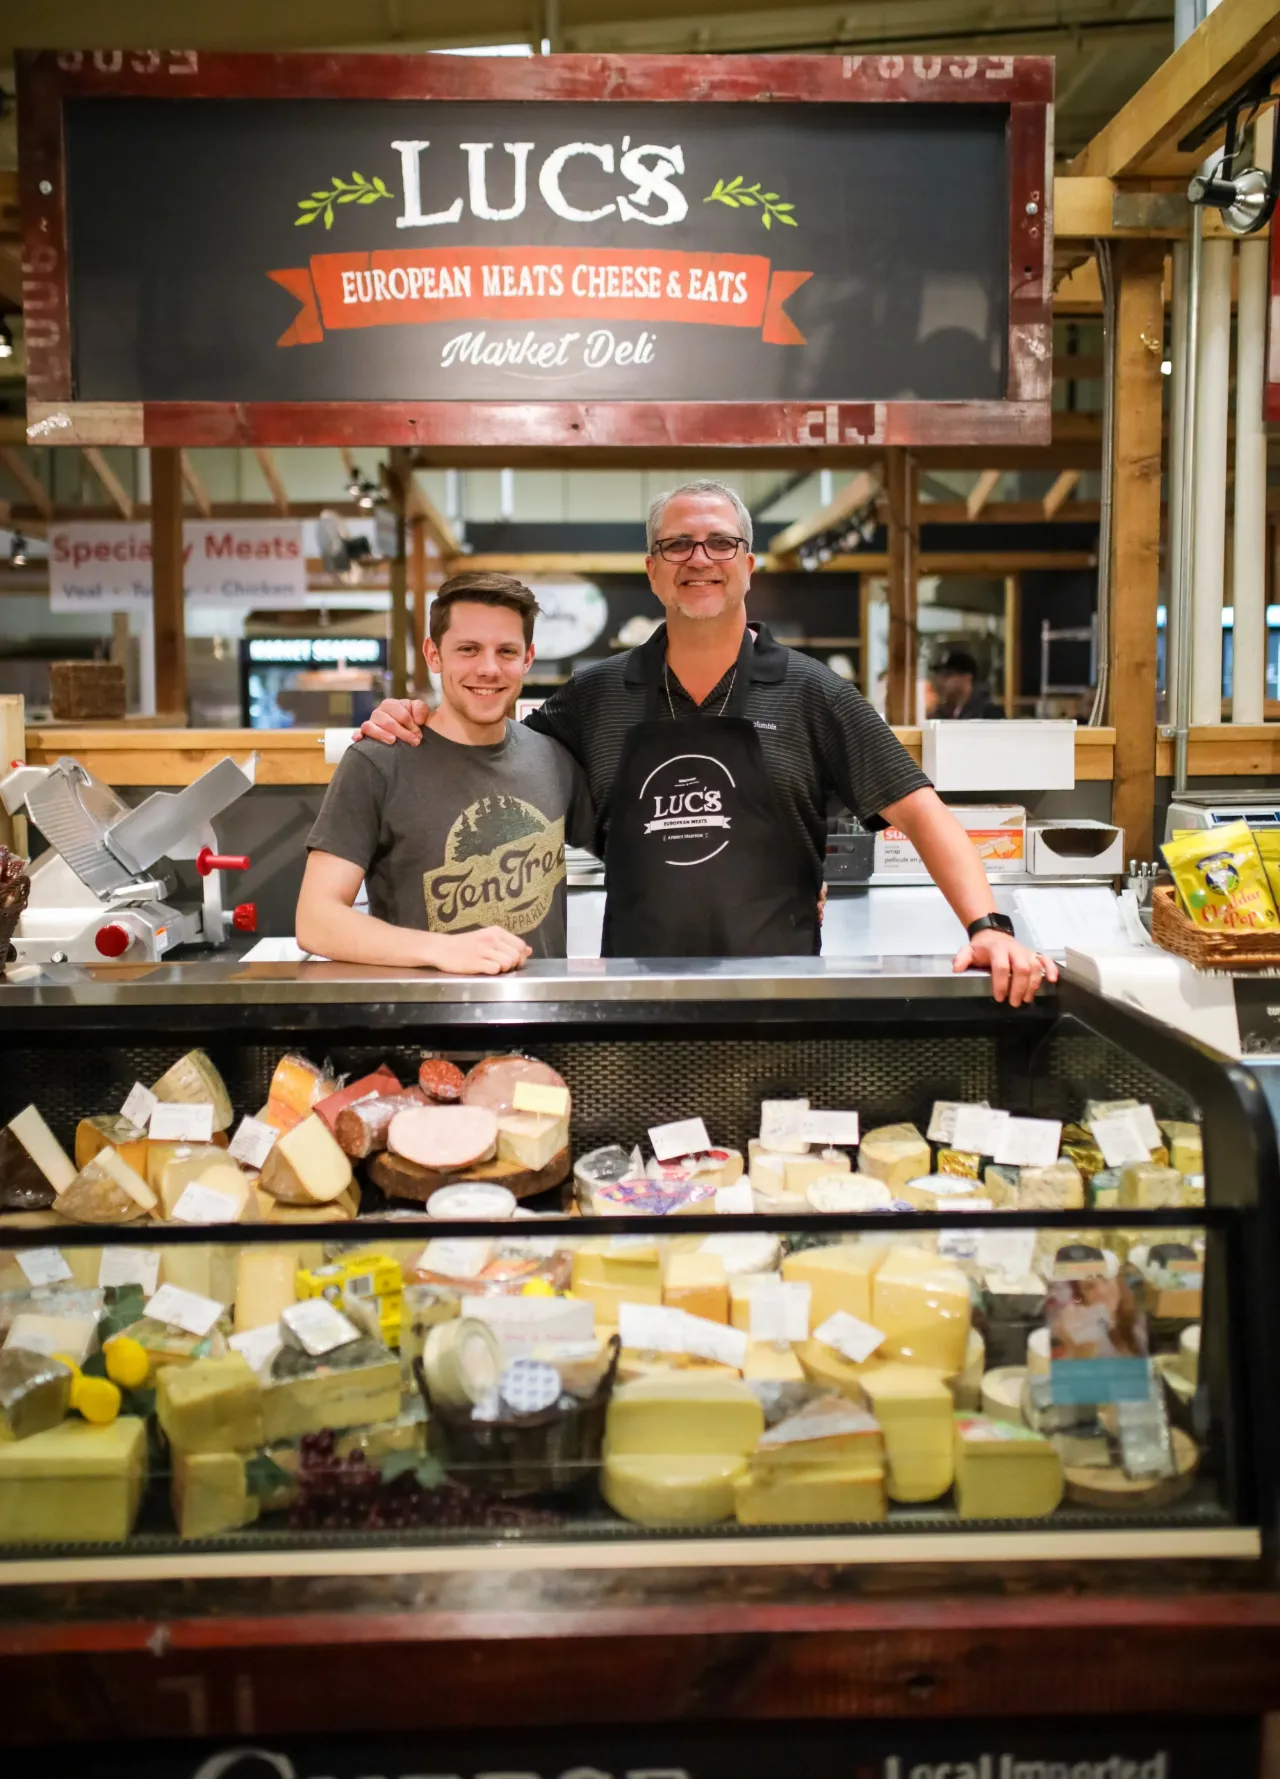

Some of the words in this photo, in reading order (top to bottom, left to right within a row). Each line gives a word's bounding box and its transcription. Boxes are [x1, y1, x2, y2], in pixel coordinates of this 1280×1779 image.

[391, 136, 689, 229] LUC'S
[341, 266, 472, 304] EUROPEAN
[482, 264, 564, 298] MEATS
[571, 264, 662, 299] CHEESE
[666, 270, 683, 299] &
[687, 268, 748, 304] EATS
[440, 331, 580, 368] Market
[583, 329, 657, 368] Deli
[53, 533, 193, 569] Speciay
[204, 532, 300, 561] Meats
[220, 580, 295, 599] Chicken
[653, 786, 723, 818] LUC'S
[884, 856, 909, 864] pellicule
